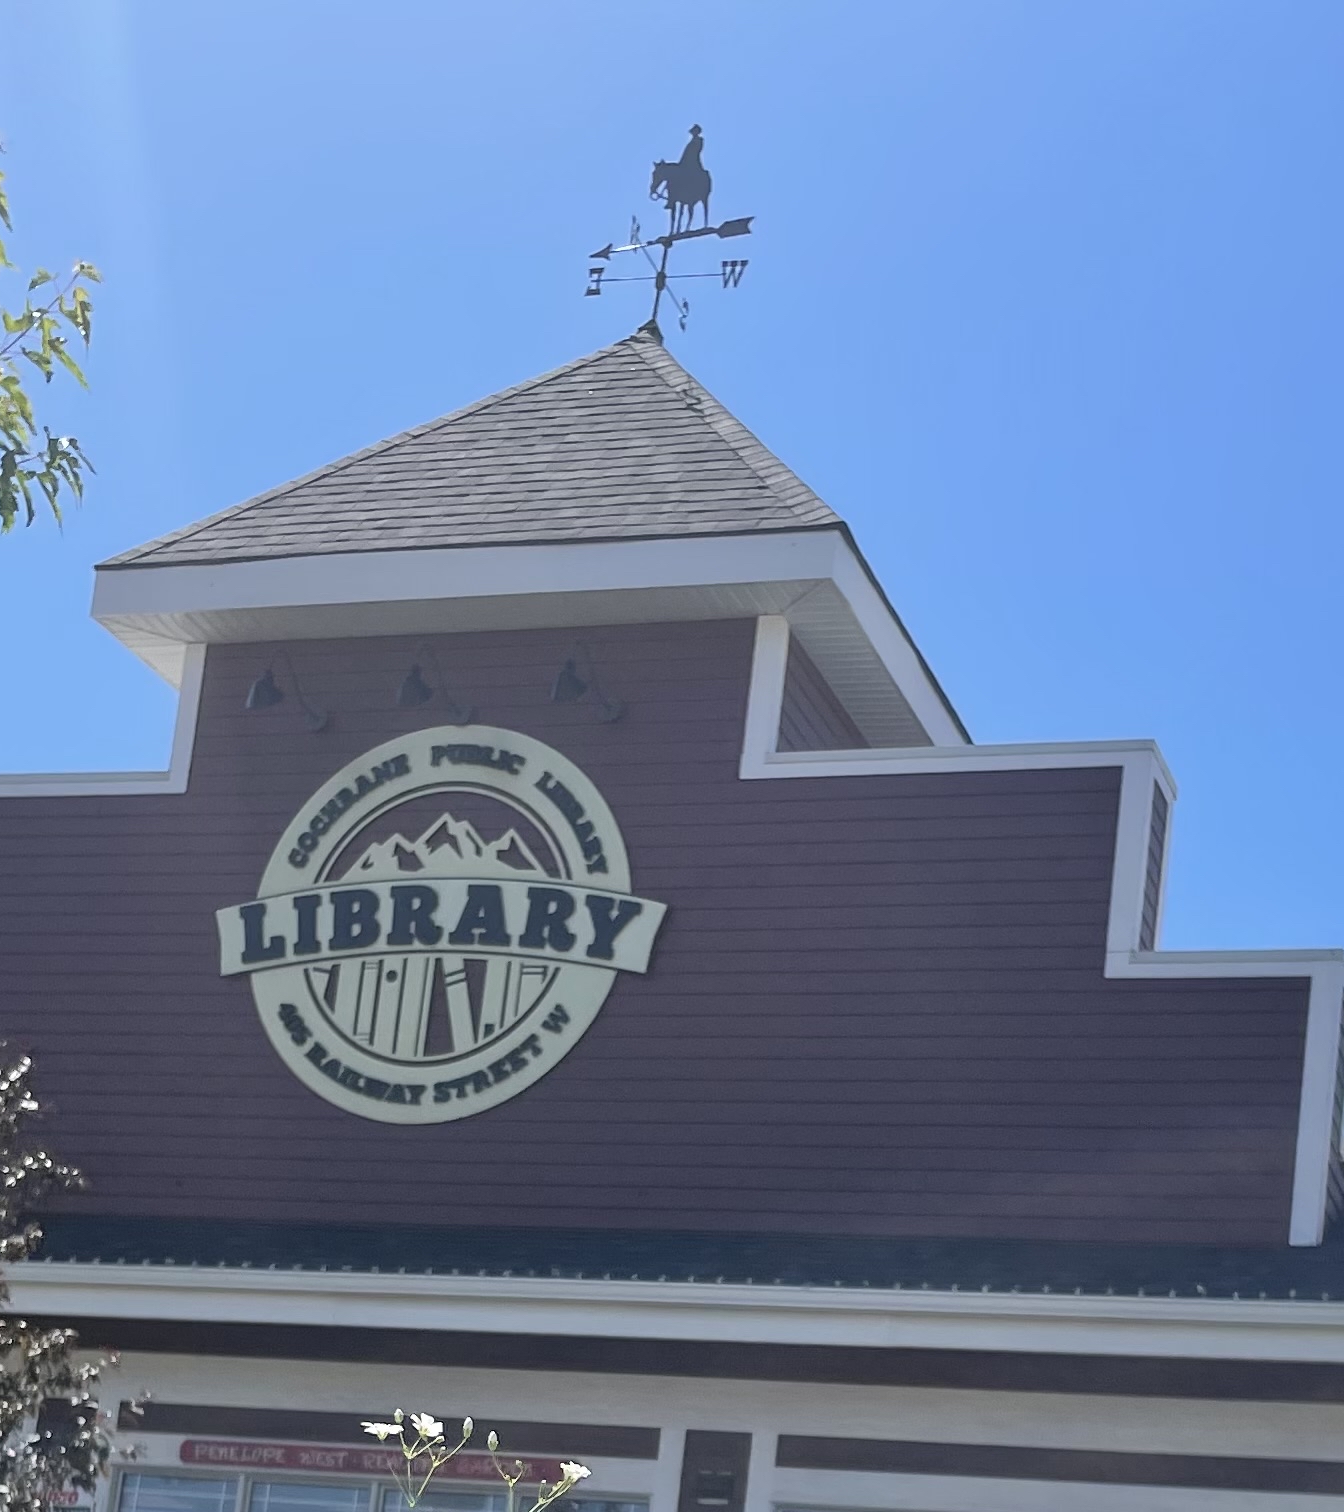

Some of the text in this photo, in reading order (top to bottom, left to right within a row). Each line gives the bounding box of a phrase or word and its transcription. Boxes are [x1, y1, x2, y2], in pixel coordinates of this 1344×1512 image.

[721, 259, 750, 289] W
[288, 743, 609, 874] COCHRANE PUBLIC LIBRARY
[239, 884, 643, 965] LIBRARY
[304, 1041, 427, 1105] RAILWAY
[433, 1033, 544, 1104] STREET
[541, 1003, 571, 1035] W
